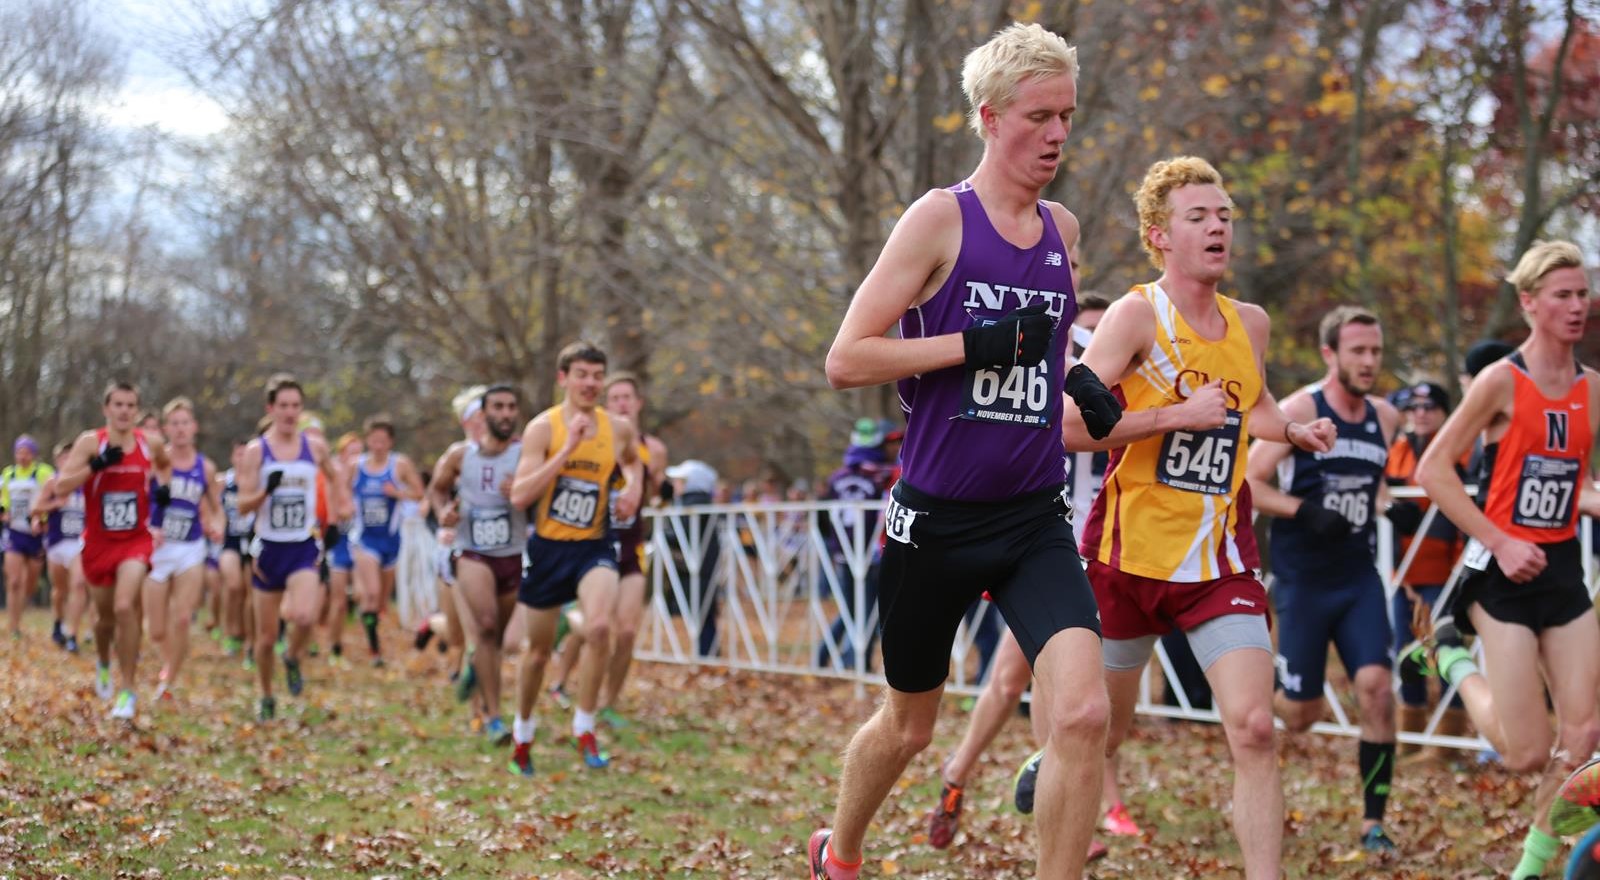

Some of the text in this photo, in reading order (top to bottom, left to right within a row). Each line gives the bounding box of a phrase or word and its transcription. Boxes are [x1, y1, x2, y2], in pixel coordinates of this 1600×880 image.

[963, 281, 1067, 318] NYU
[972, 359, 1048, 412] 646
[1174, 369, 1242, 411] CS
[976, 409, 1013, 421] NOVEMBER
[1024, 415, 1040, 423] 2016
[1543, 408, 1568, 452] N
[1165, 431, 1233, 484] 545
[104, 501, 137, 529] 524
[552, 489, 597, 523] 490
[1323, 491, 1369, 526] 606
[1519, 477, 1574, 520] 667
[473, 518, 510, 545] 689
